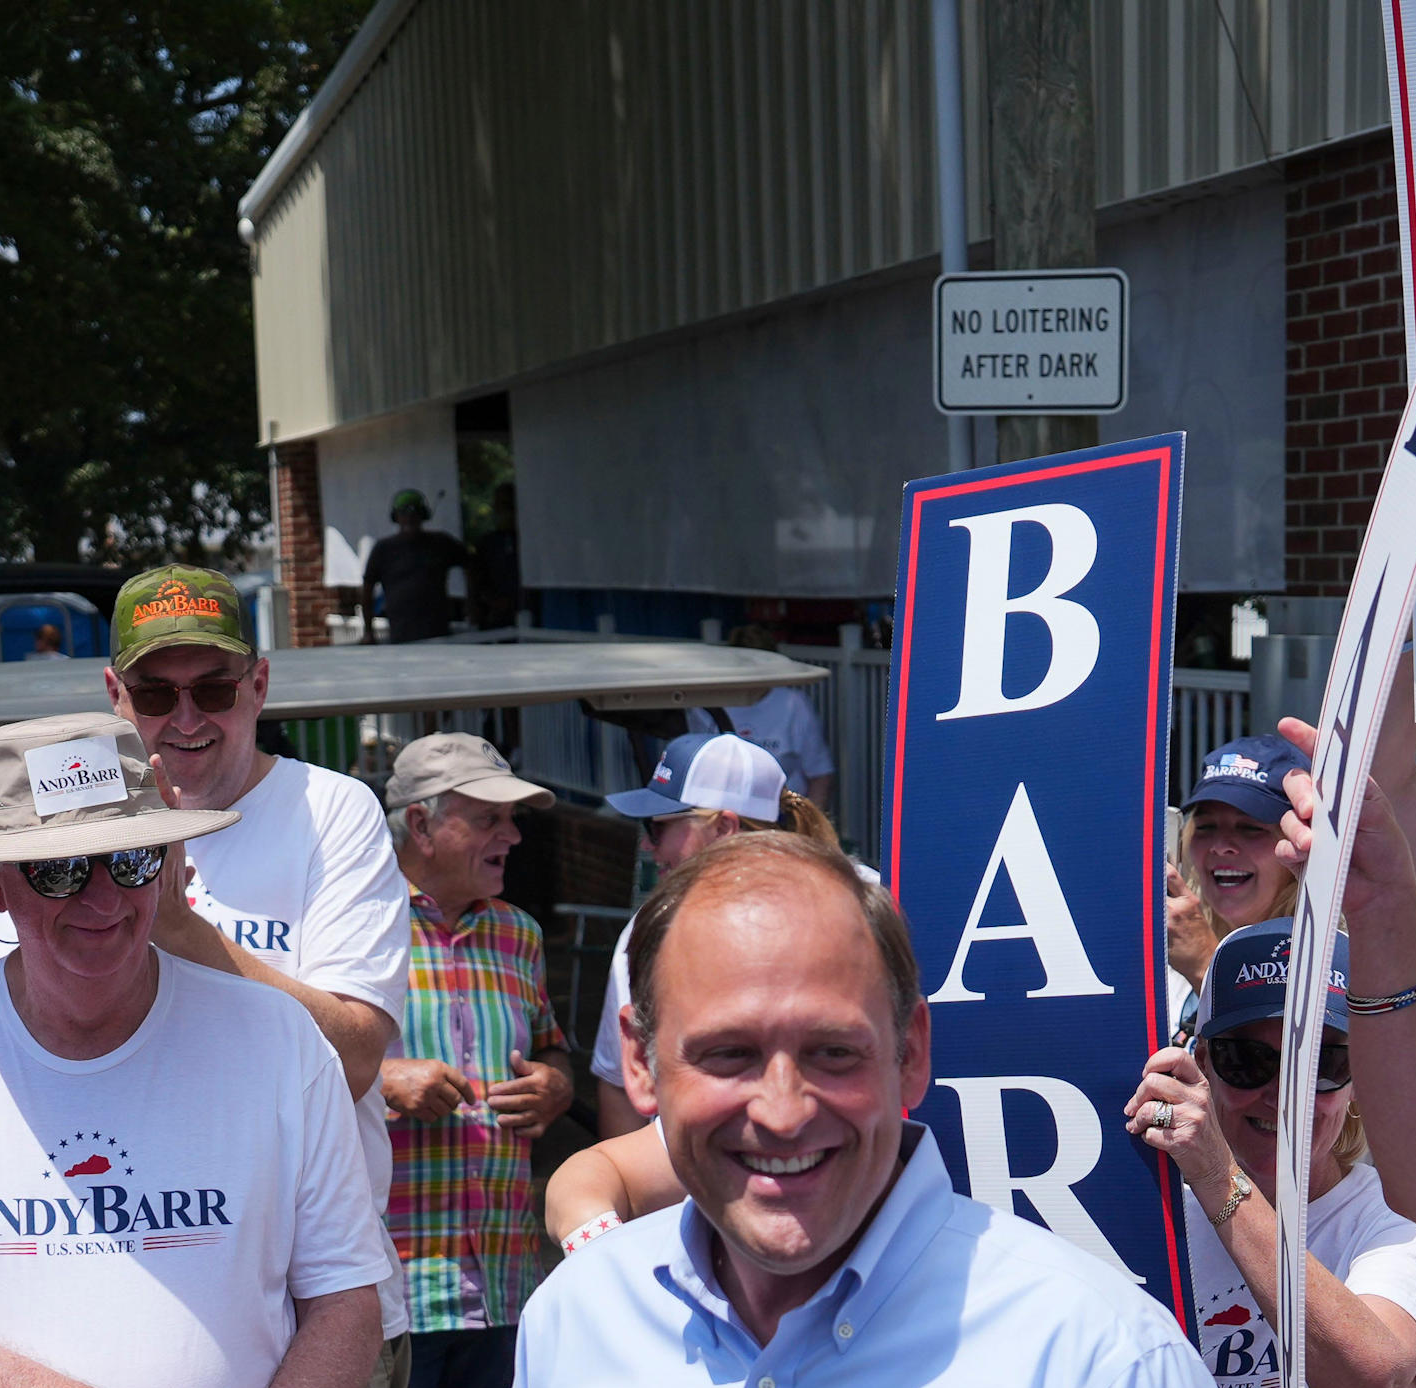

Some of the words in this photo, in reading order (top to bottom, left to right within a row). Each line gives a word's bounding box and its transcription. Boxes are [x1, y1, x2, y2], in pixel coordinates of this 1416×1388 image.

[952, 309, 982, 334] NO
[992, 307, 1110, 334] LOITERING
[960, 354, 1030, 379] AFTER
[1038, 352, 1099, 378] DARK
[1239, 767, 1269, 783] PAC
[46, 1243, 72, 1256] U.S.
[75, 1239, 136, 1256] SENATE
